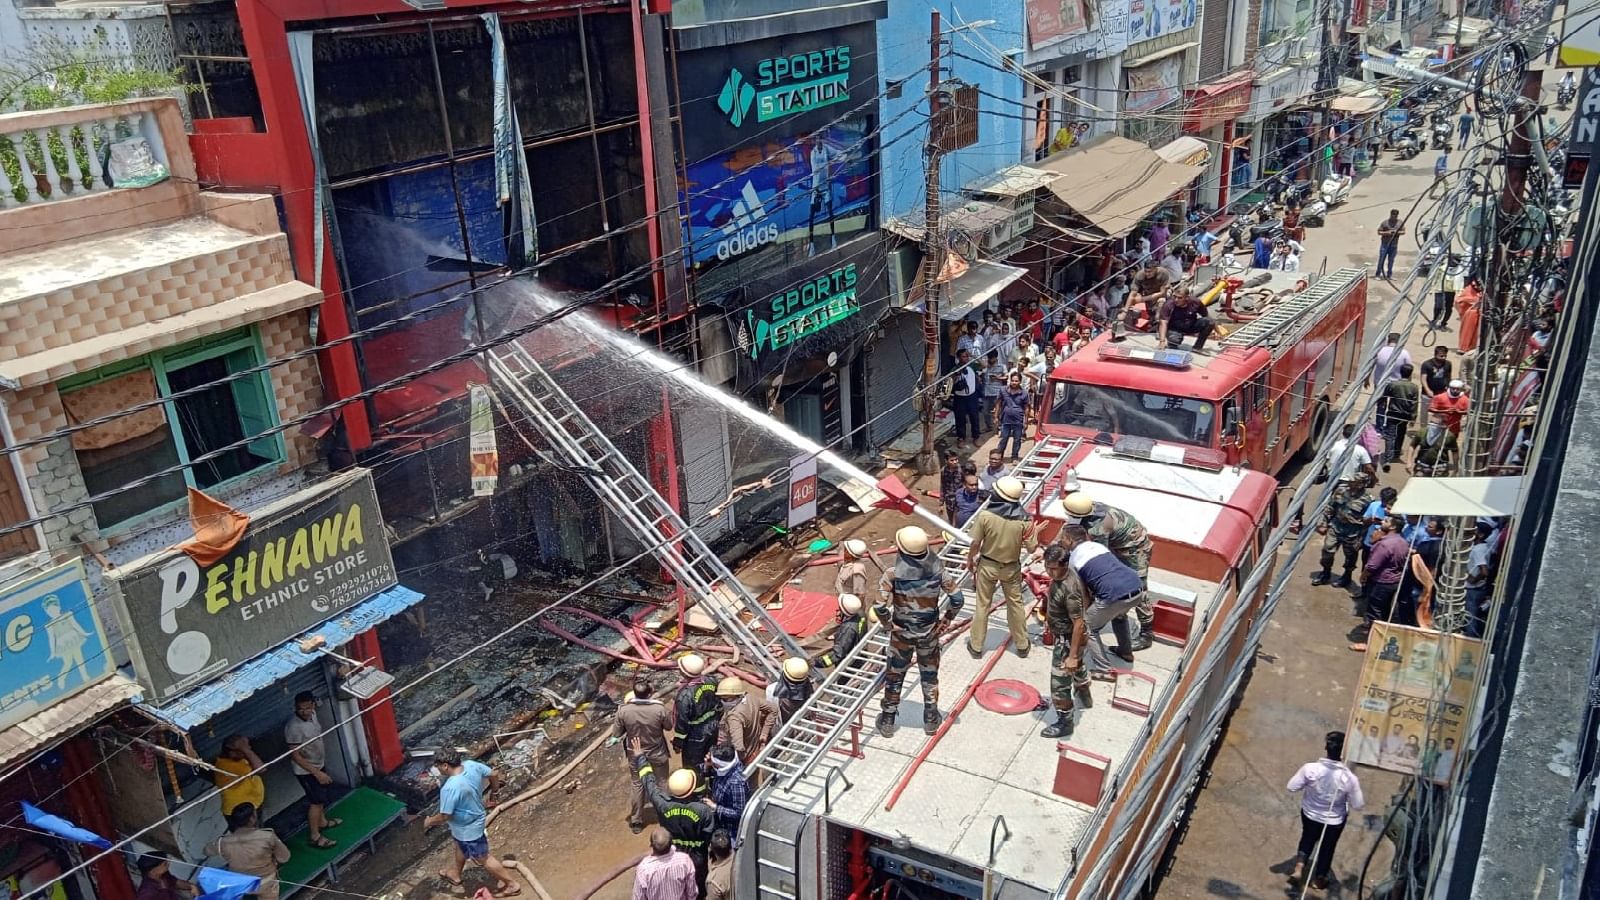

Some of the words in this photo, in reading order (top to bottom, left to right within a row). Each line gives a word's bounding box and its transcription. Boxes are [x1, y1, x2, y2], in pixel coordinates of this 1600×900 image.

[757, 46, 849, 86] SPORTS
[760, 78, 848, 116] STATION
[717, 222, 778, 261] adidas
[771, 263, 857, 320] SPORTS
[775, 290, 860, 346] STATION
[159, 503, 364, 633] PEHNAWA
[241, 576, 310, 622] ETHNIC
[313, 549, 368, 585] STORE
[329, 561, 389, 598] 7292921076
[0, 614, 33, 660] G
